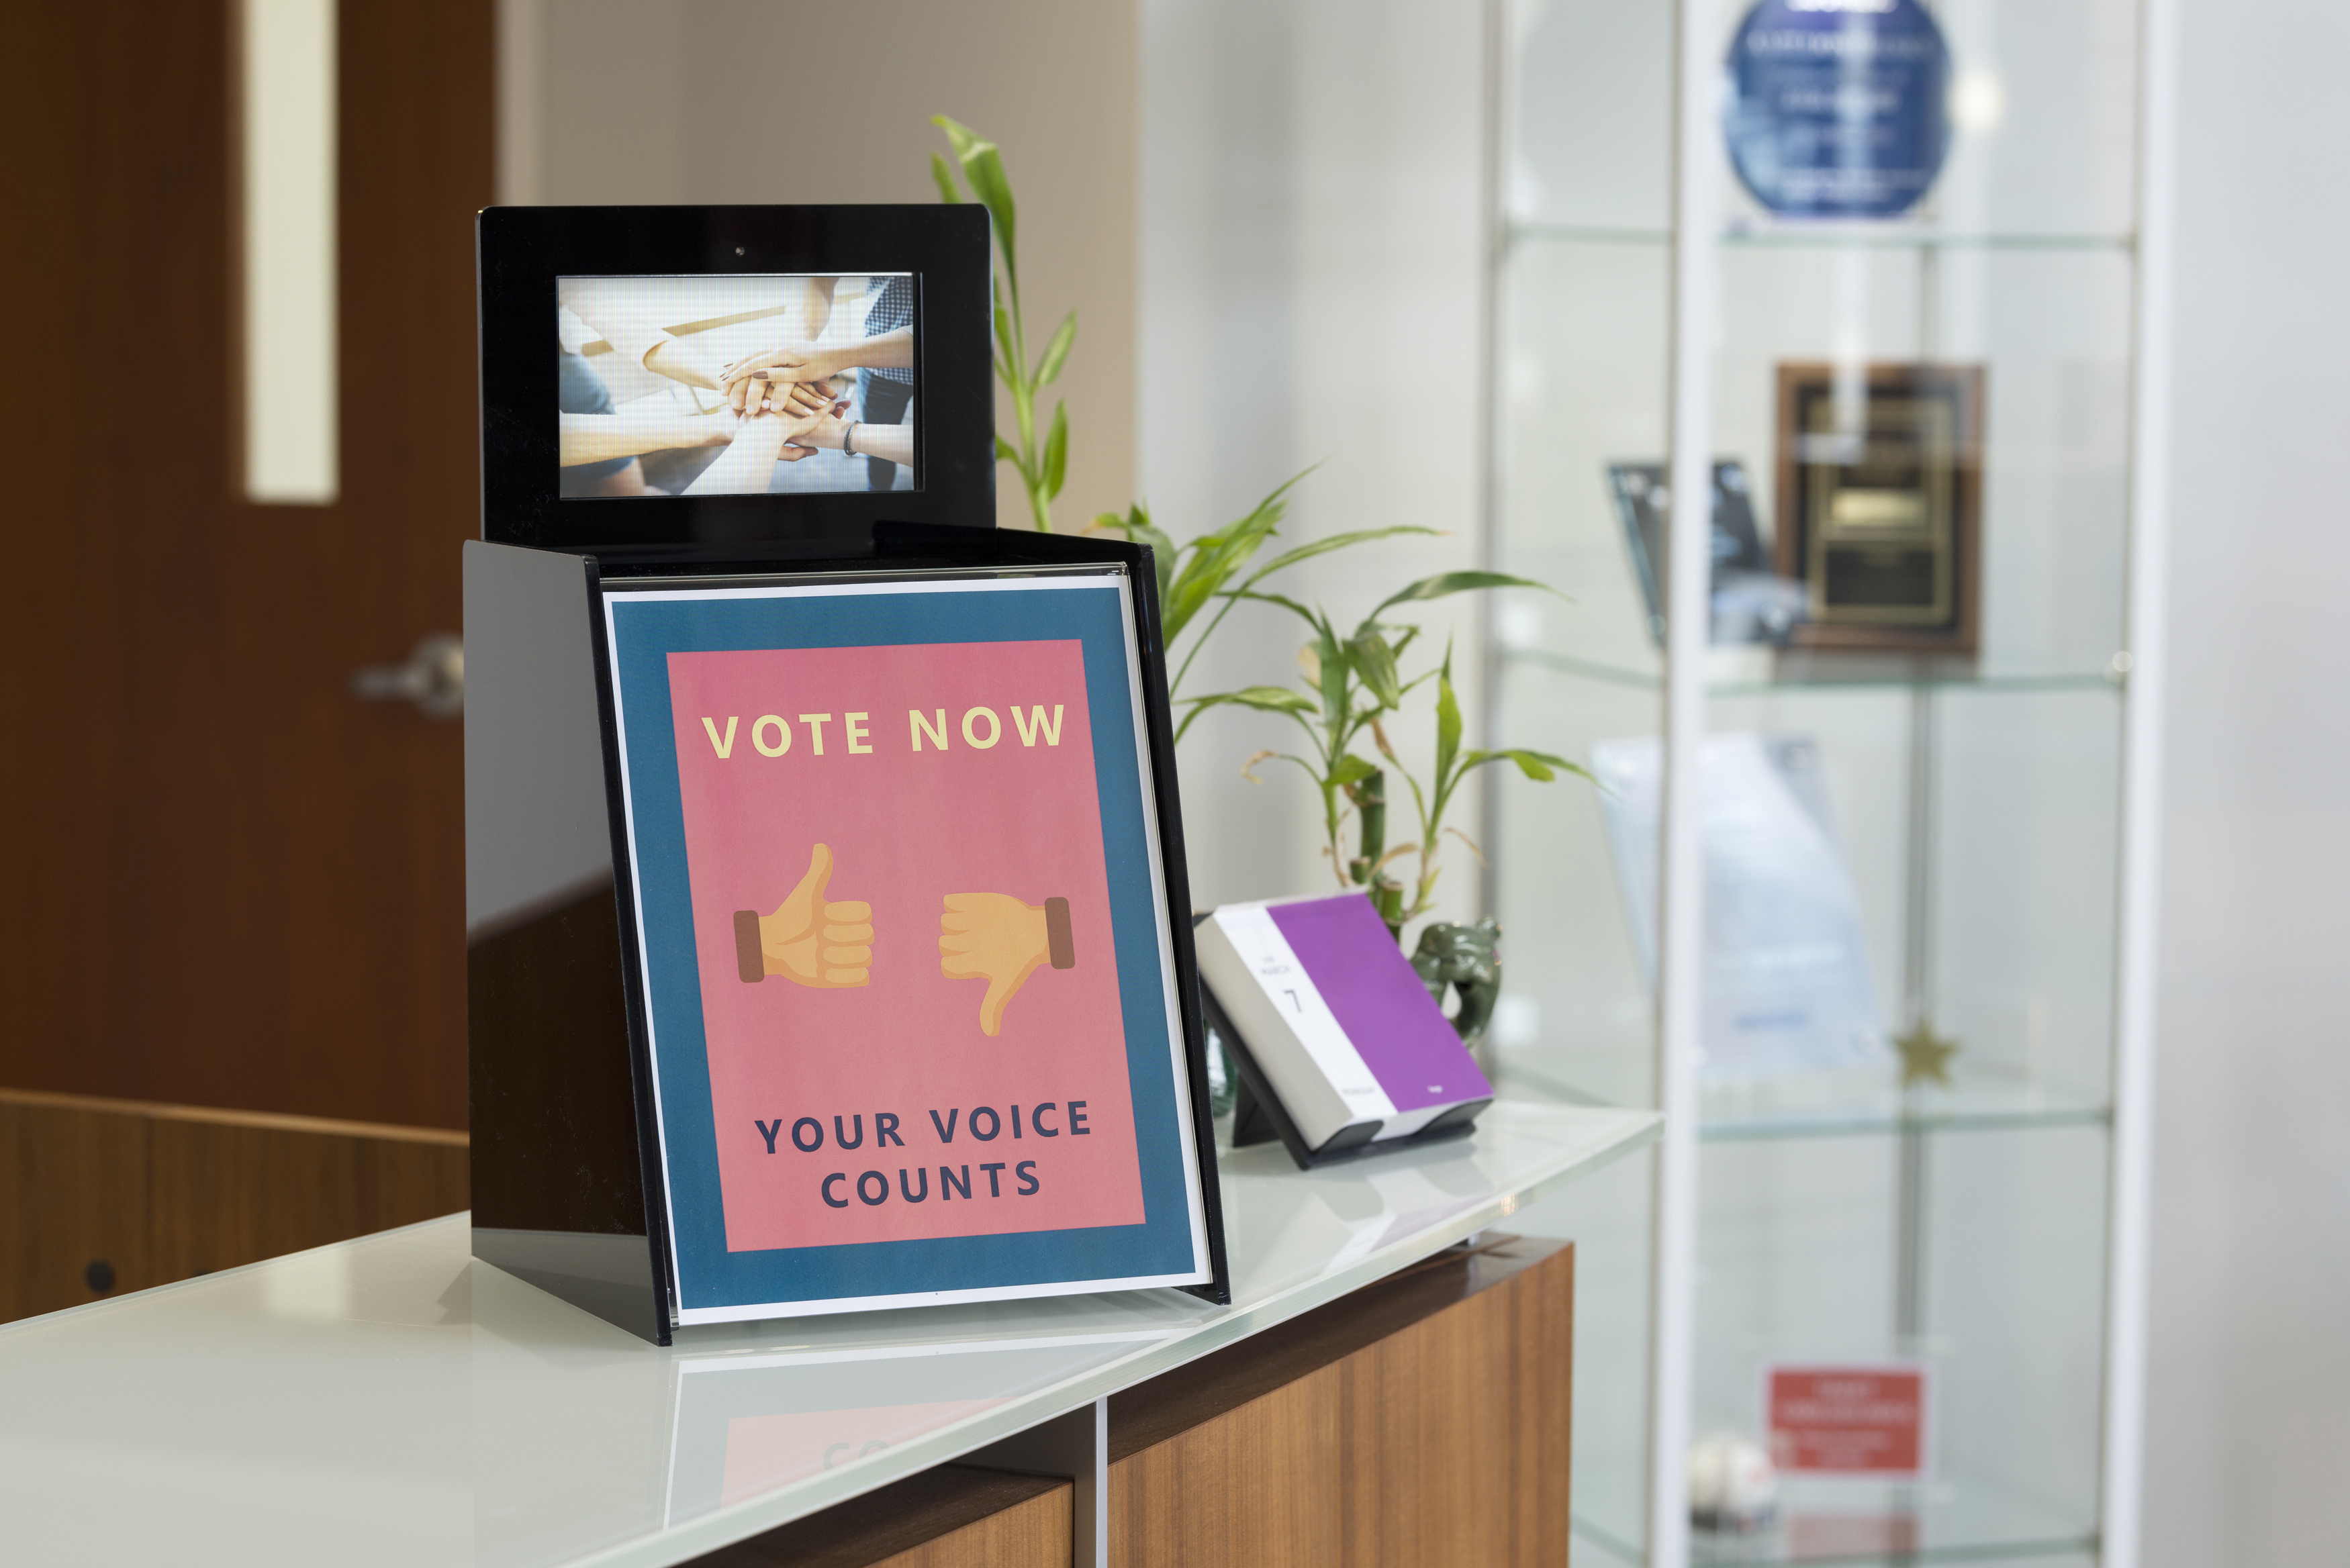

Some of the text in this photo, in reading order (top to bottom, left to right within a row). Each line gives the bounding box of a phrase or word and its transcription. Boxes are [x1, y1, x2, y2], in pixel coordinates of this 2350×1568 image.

[702, 705, 1064, 758] VOTE NOW
[1283, 989, 1301, 1012] 7
[754, 1100, 1090, 1155] YOUR VOICE
[821, 1161, 1040, 1208] COUNTS
